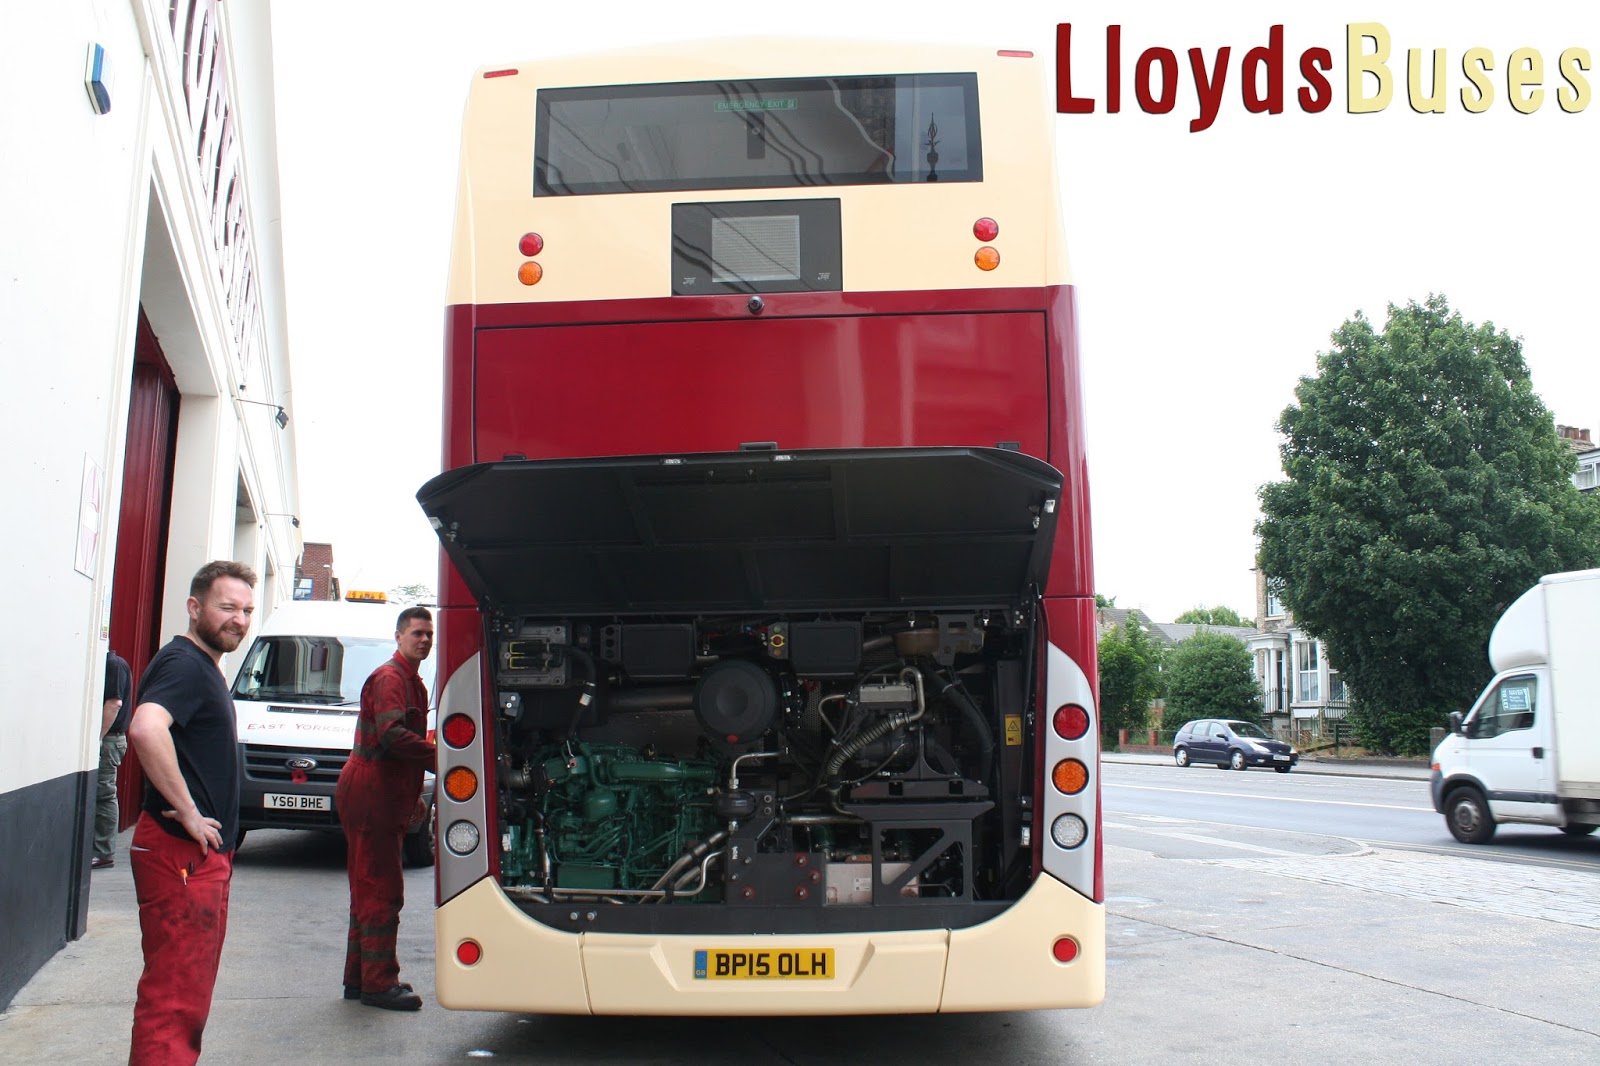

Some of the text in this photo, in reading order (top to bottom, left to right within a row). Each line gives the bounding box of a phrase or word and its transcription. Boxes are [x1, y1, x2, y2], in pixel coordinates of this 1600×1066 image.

[717, 100, 784, 110] EMERGENCY EXIT
[295, 723, 355, 734] YORKSHI
[291, 760, 309, 768] Ford
[271, 795, 324, 809] YS61 BHE
[715, 952, 826, 976] BP15 OLH
